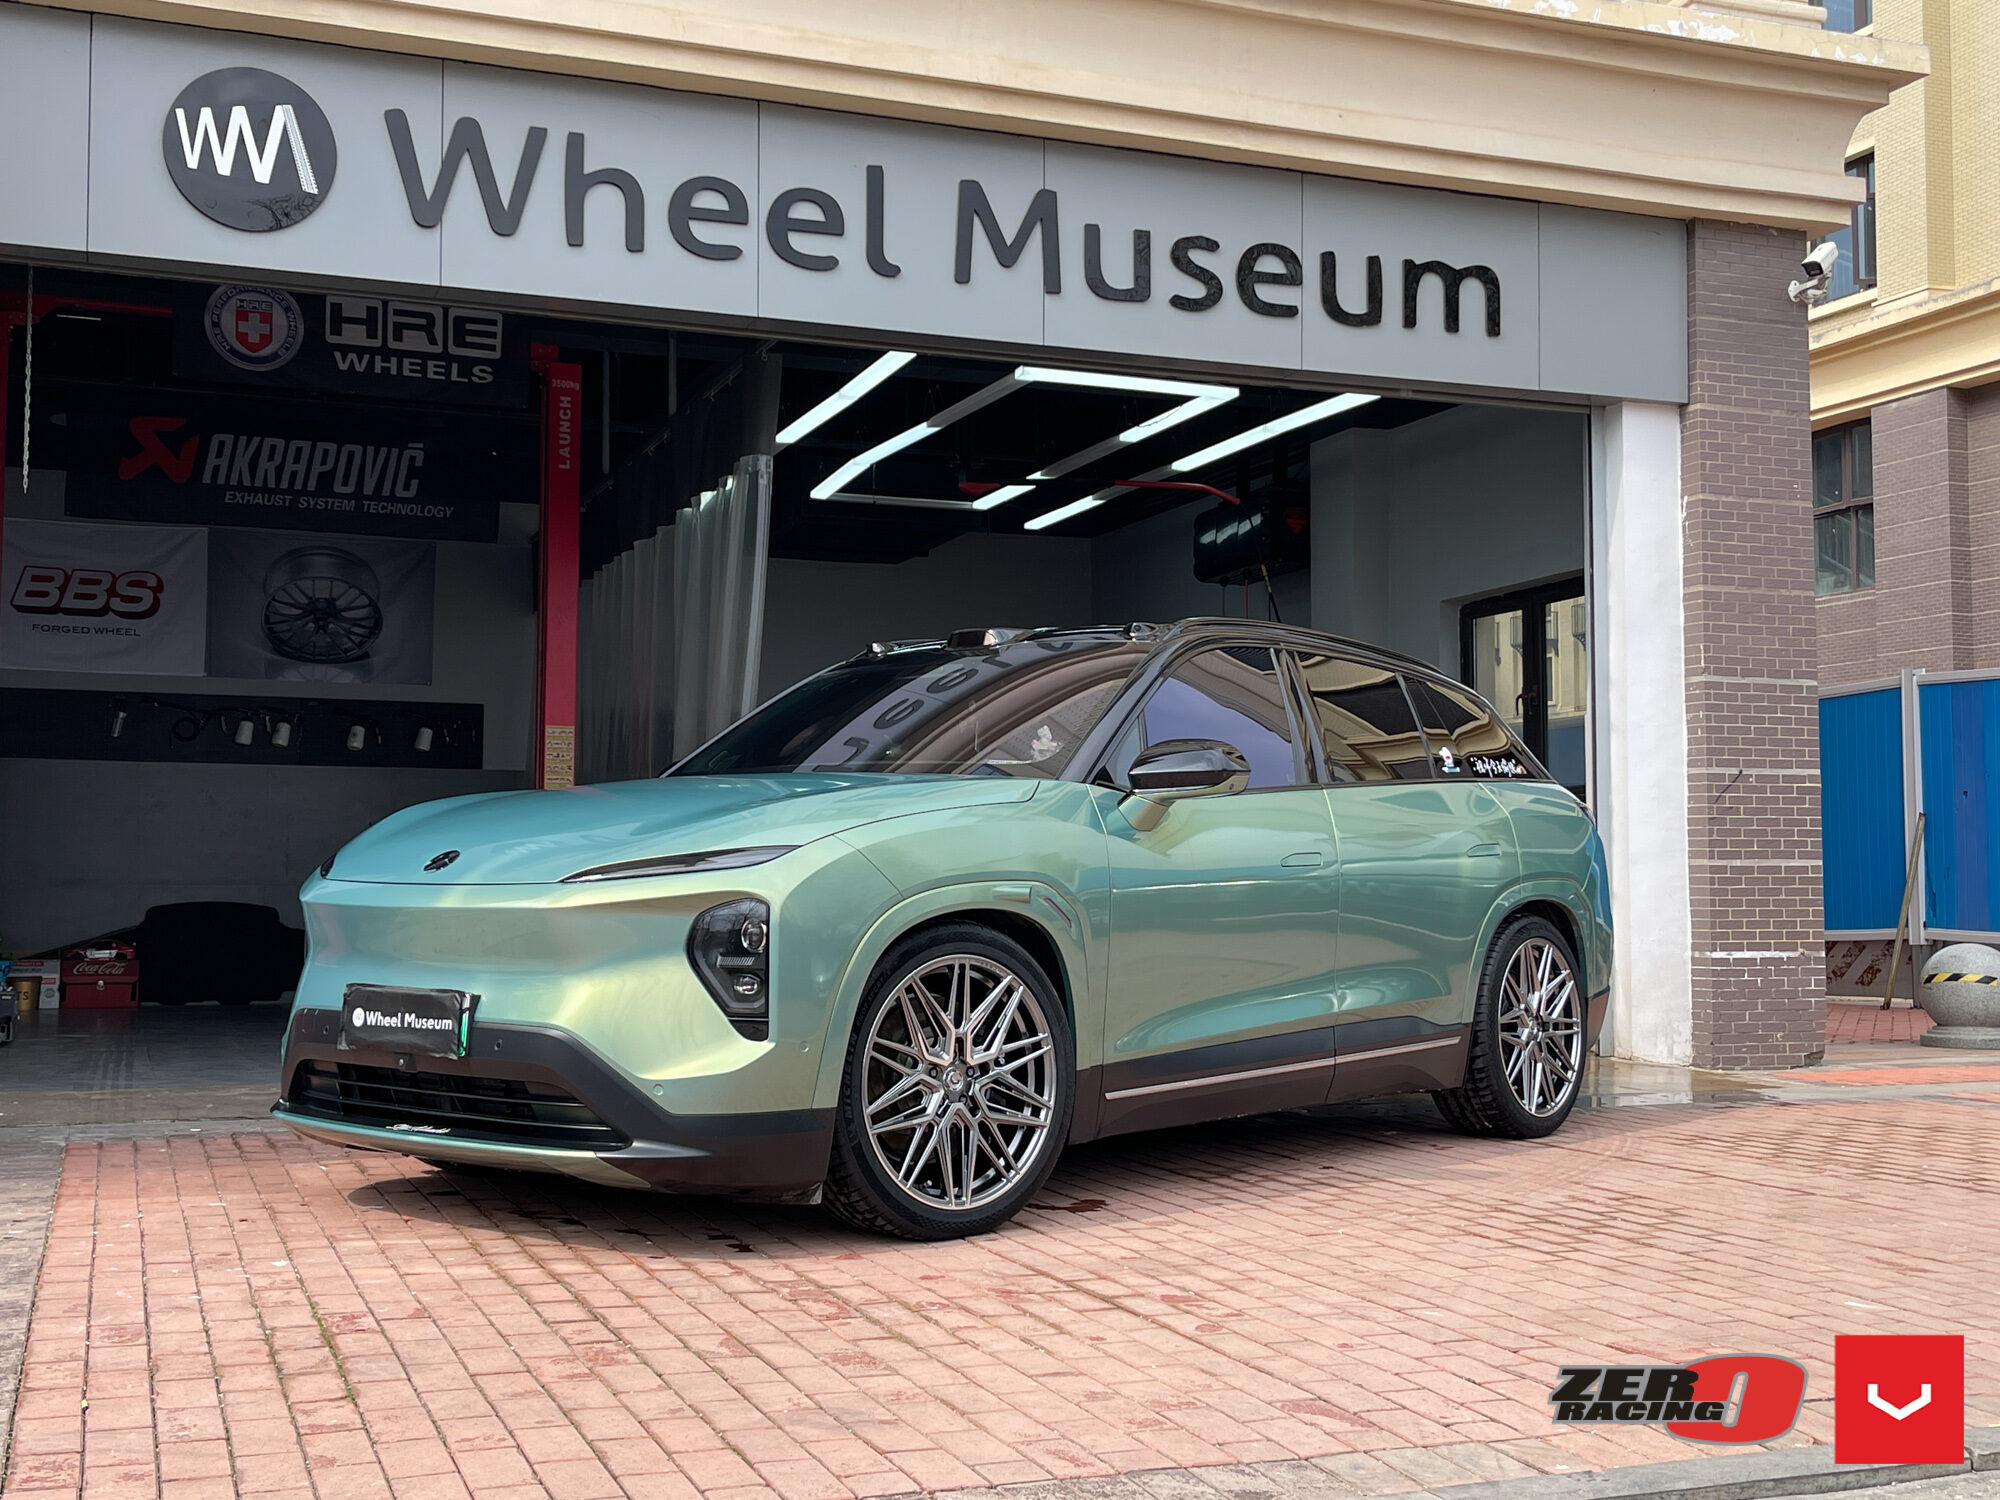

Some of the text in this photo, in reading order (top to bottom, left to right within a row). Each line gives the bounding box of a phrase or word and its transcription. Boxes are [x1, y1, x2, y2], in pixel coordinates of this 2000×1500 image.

[384, 108, 1501, 337] Wheel Museum
[235, 299, 273, 311] HRE
[327, 297, 501, 356] HRE
[333, 351, 494, 384] WHEELS
[558, 396, 572, 469] LAUNCH
[224, 490, 455, 519] EXHAUST SYSTEM TECHNOLOGY
[10, 565, 164, 620] BBS
[32, 623, 141, 637] FORGED WHEEL
[365, 1010, 402, 1028] Wheel
[404, 1012, 453, 1030] Museum
